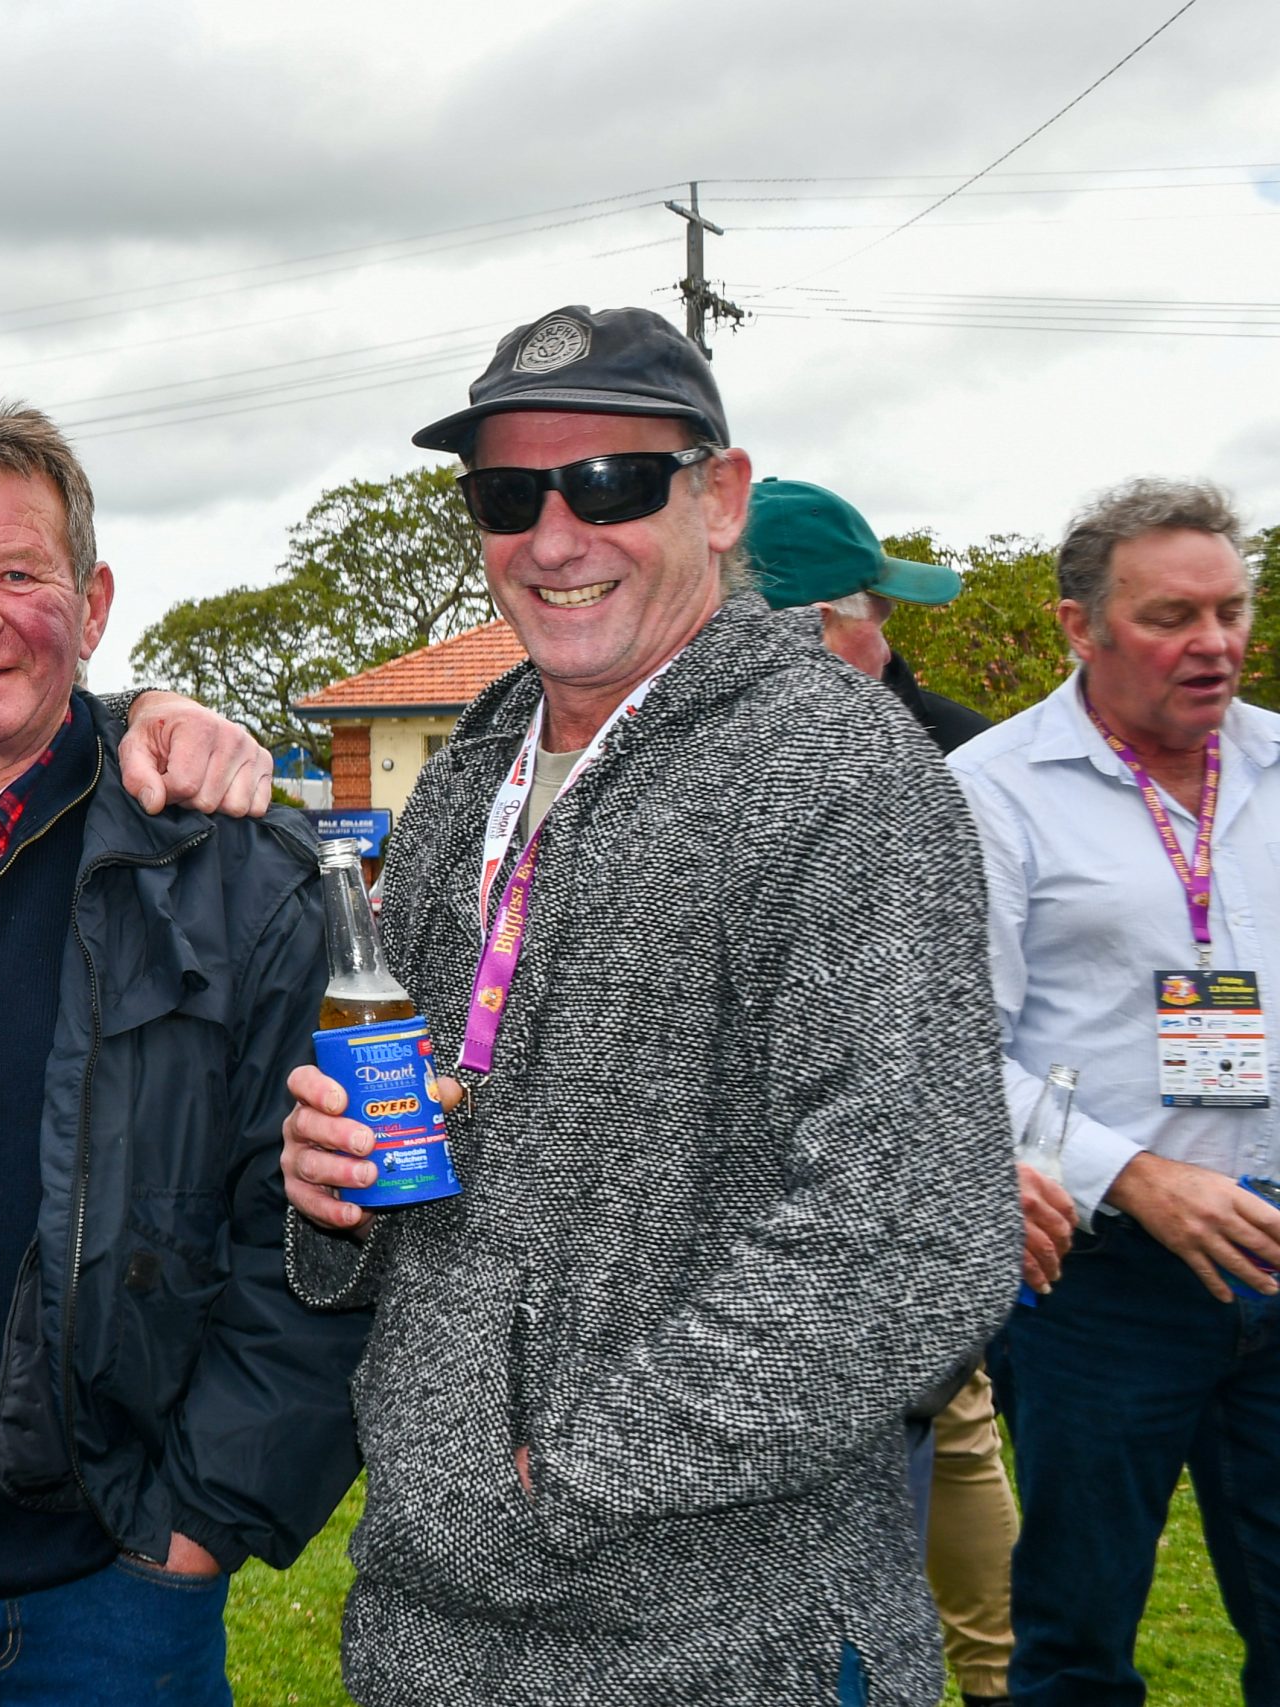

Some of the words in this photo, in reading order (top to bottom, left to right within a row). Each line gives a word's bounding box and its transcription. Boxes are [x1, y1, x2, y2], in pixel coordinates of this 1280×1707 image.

[529, 325, 579, 349] FURPHY
[318, 819, 338, 828] SALE
[340, 819, 374, 828] COLLEGE
[499, 799, 521, 837] Duart
[492, 885, 524, 955] Biggest
[351, 1044, 413, 1063] Times
[355, 1063, 417, 1083] Duart
[370, 1100, 417, 1114] DYERS
